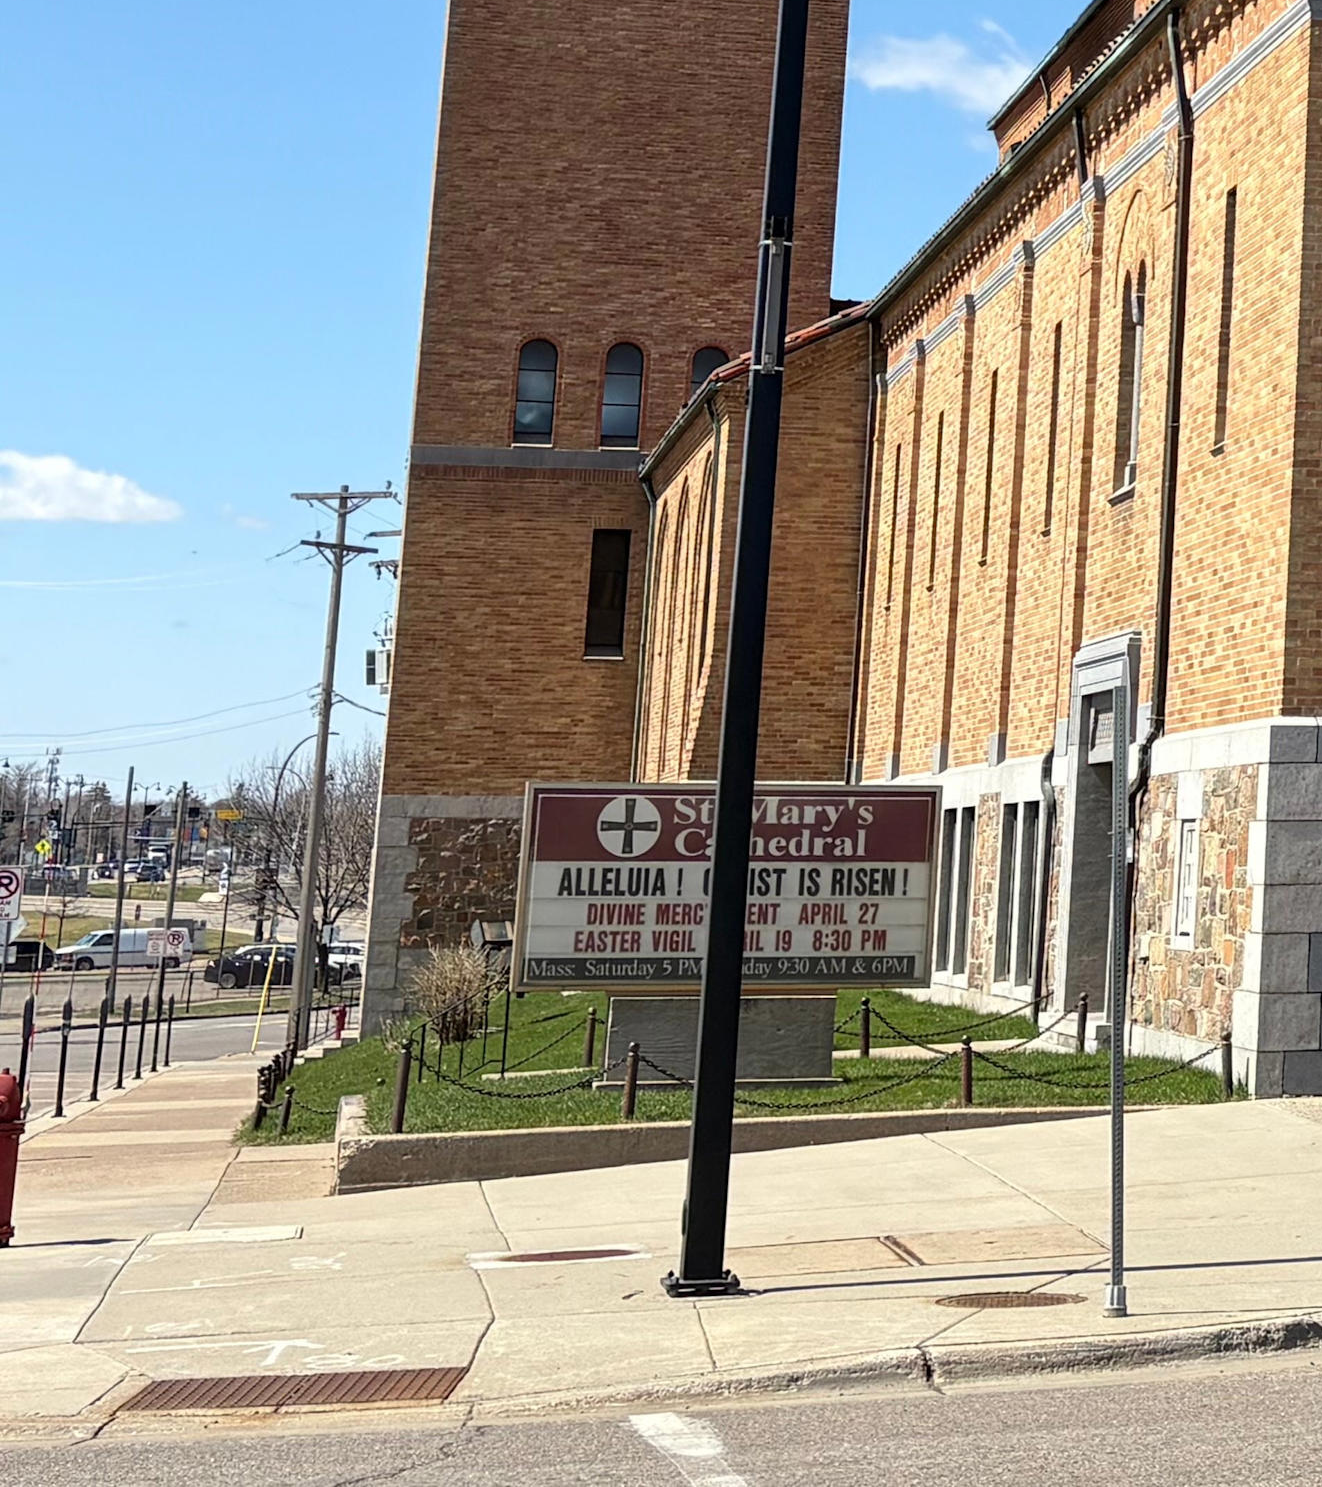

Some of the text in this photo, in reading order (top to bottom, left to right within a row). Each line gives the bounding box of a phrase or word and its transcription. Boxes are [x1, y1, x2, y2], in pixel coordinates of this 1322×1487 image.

[557, 867, 666, 897] ALLELUIA
[798, 867, 821, 897] IS
[586, 903, 646, 926] DIVINE
[655, 903, 708, 926] MERC
[798, 903, 848, 925] APRIL
[858, 903, 880, 925] 27
[573, 930, 641, 953] EASTER
[652, 930, 696, 953] VIGIL
[775, 929, 792, 952] 19
[812, 929, 852, 952] 8:30
[861, 929, 887, 952] PM
[529, 960, 575, 977] Mass:
[585, 959, 657, 979] Saturday
[663, 960, 672, 975] 5
[778, 958, 809, 975] 9:30
[815, 958, 846, 974] AM
[852, 958, 866, 974] &
[872, 958, 908, 974] 6PM
